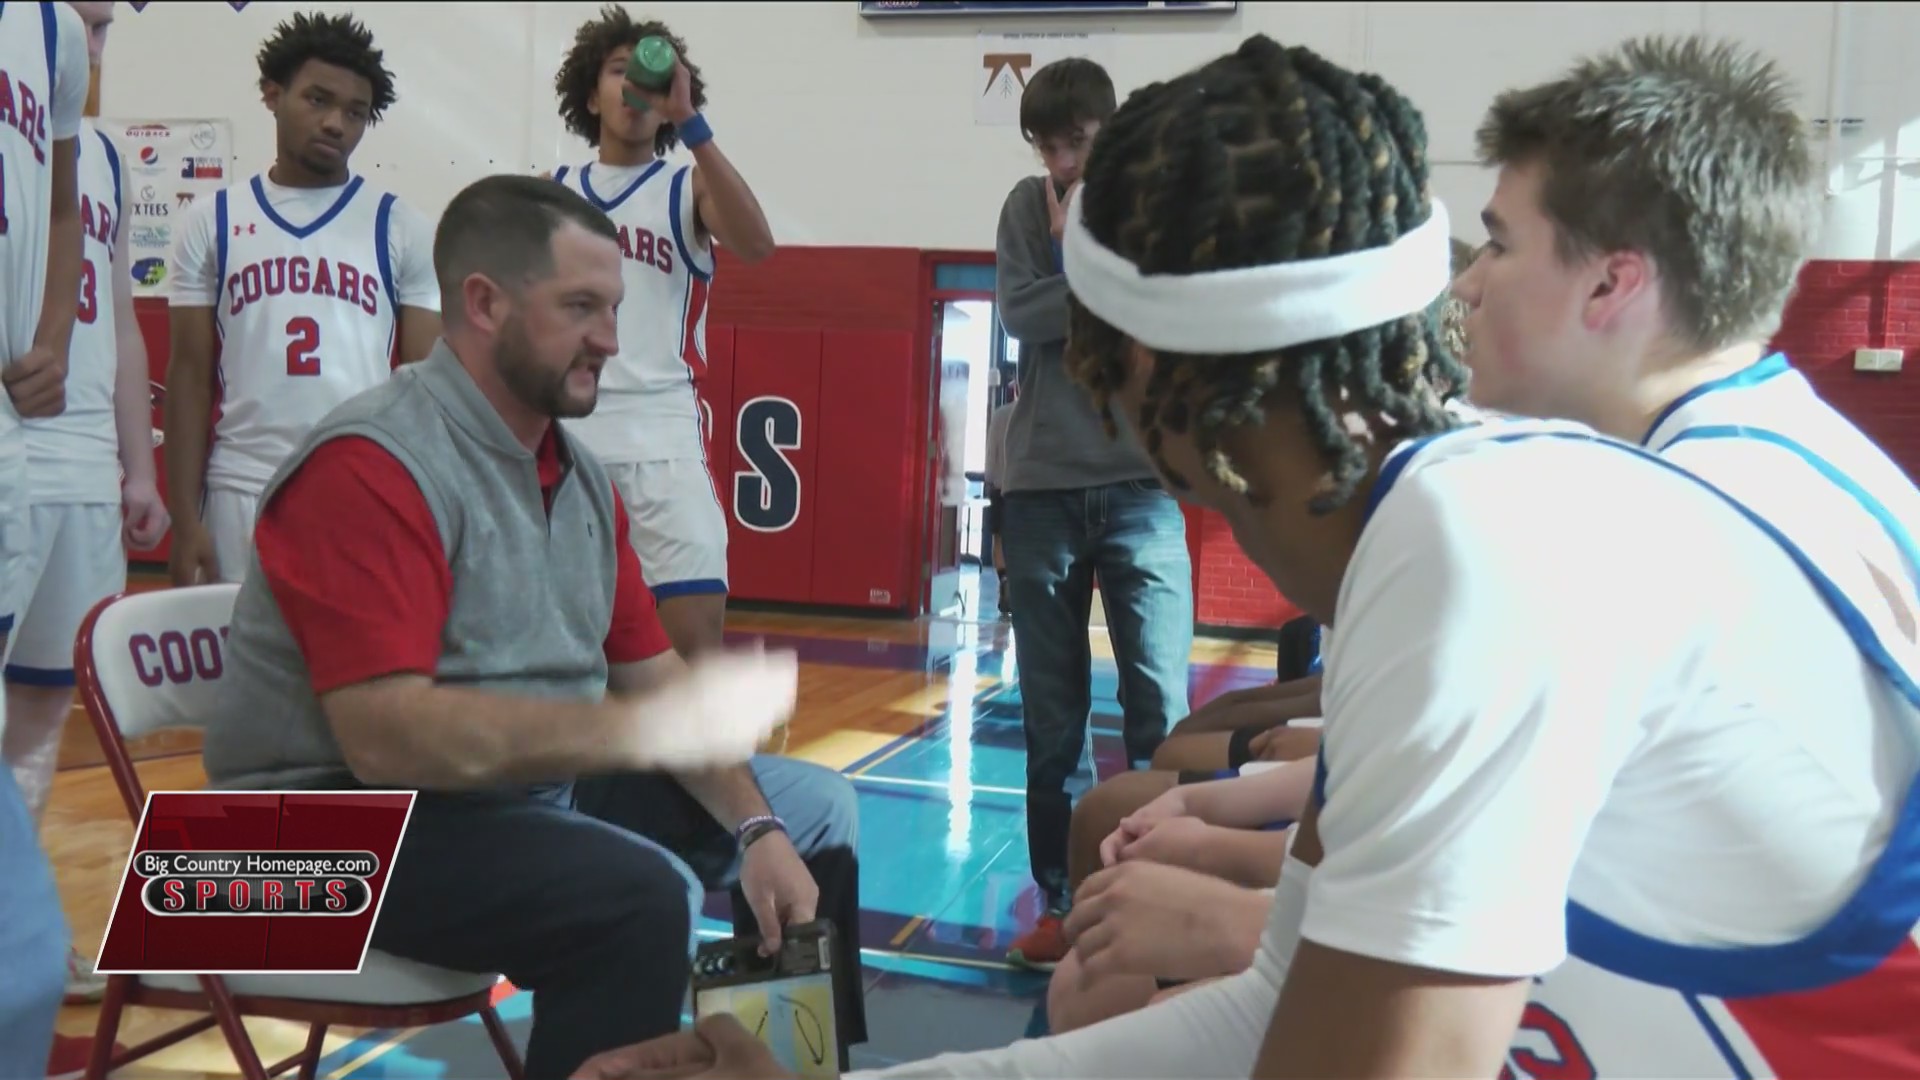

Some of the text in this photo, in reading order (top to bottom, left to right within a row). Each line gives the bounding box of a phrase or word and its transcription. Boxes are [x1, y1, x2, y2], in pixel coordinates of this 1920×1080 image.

[143, 203, 169, 216] TEES
[227, 256, 379, 316] COUGARS
[286, 316, 321, 376] 2
[700, 395, 802, 532] S
[128, 626, 229, 688] COO
